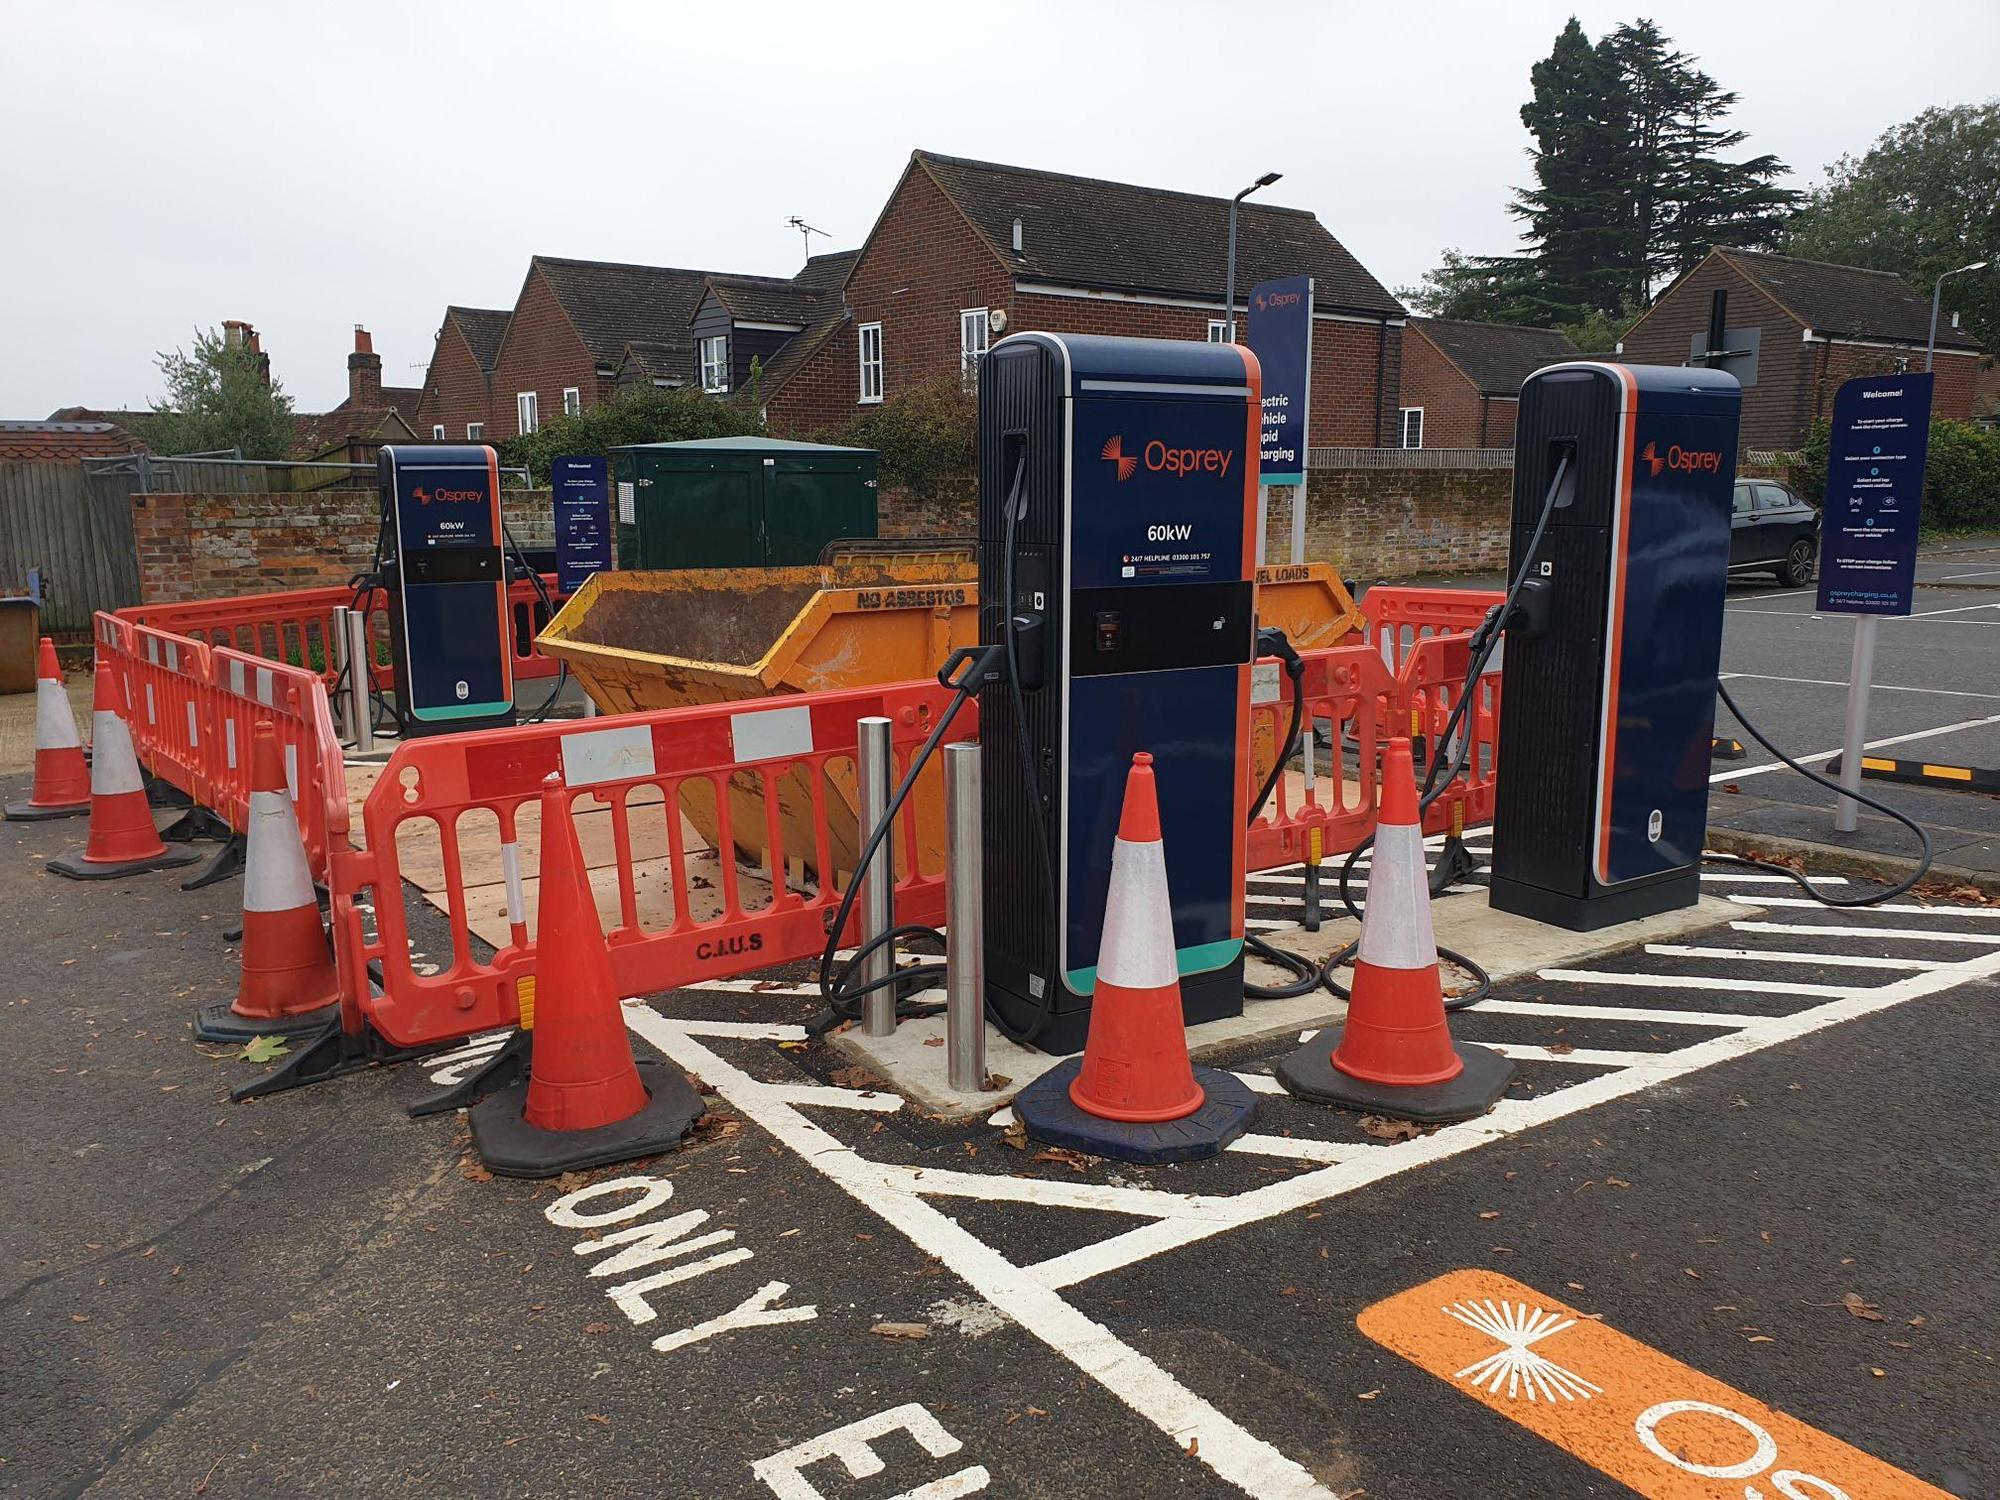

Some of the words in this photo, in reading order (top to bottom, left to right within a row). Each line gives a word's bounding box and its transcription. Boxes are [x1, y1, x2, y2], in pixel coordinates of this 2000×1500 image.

[1269, 293, 1301, 307] Osprey
[1261, 393, 1289, 408] ectric
[1863, 389, 1903, 399] Welcome!
[1261, 411, 1287, 426] hicle
[1261, 429, 1278, 445] pid
[1145, 440, 1233, 478] Osprey
[1668, 445, 1722, 474] Osprey
[435, 488, 483, 503] Osprey
[440, 522, 464, 530] 60kW
[1147, 525, 1192, 541] 60kW
[1144, 554, 1170, 562] HELPLINE
[1276, 567, 1309, 582] LOADS
[857, 592, 881, 608] NO
[886, 589, 965, 608] ASBESTOS
[696, 933, 763, 960] C.I.U.S
[544, 1176, 818, 1352] ONLY
